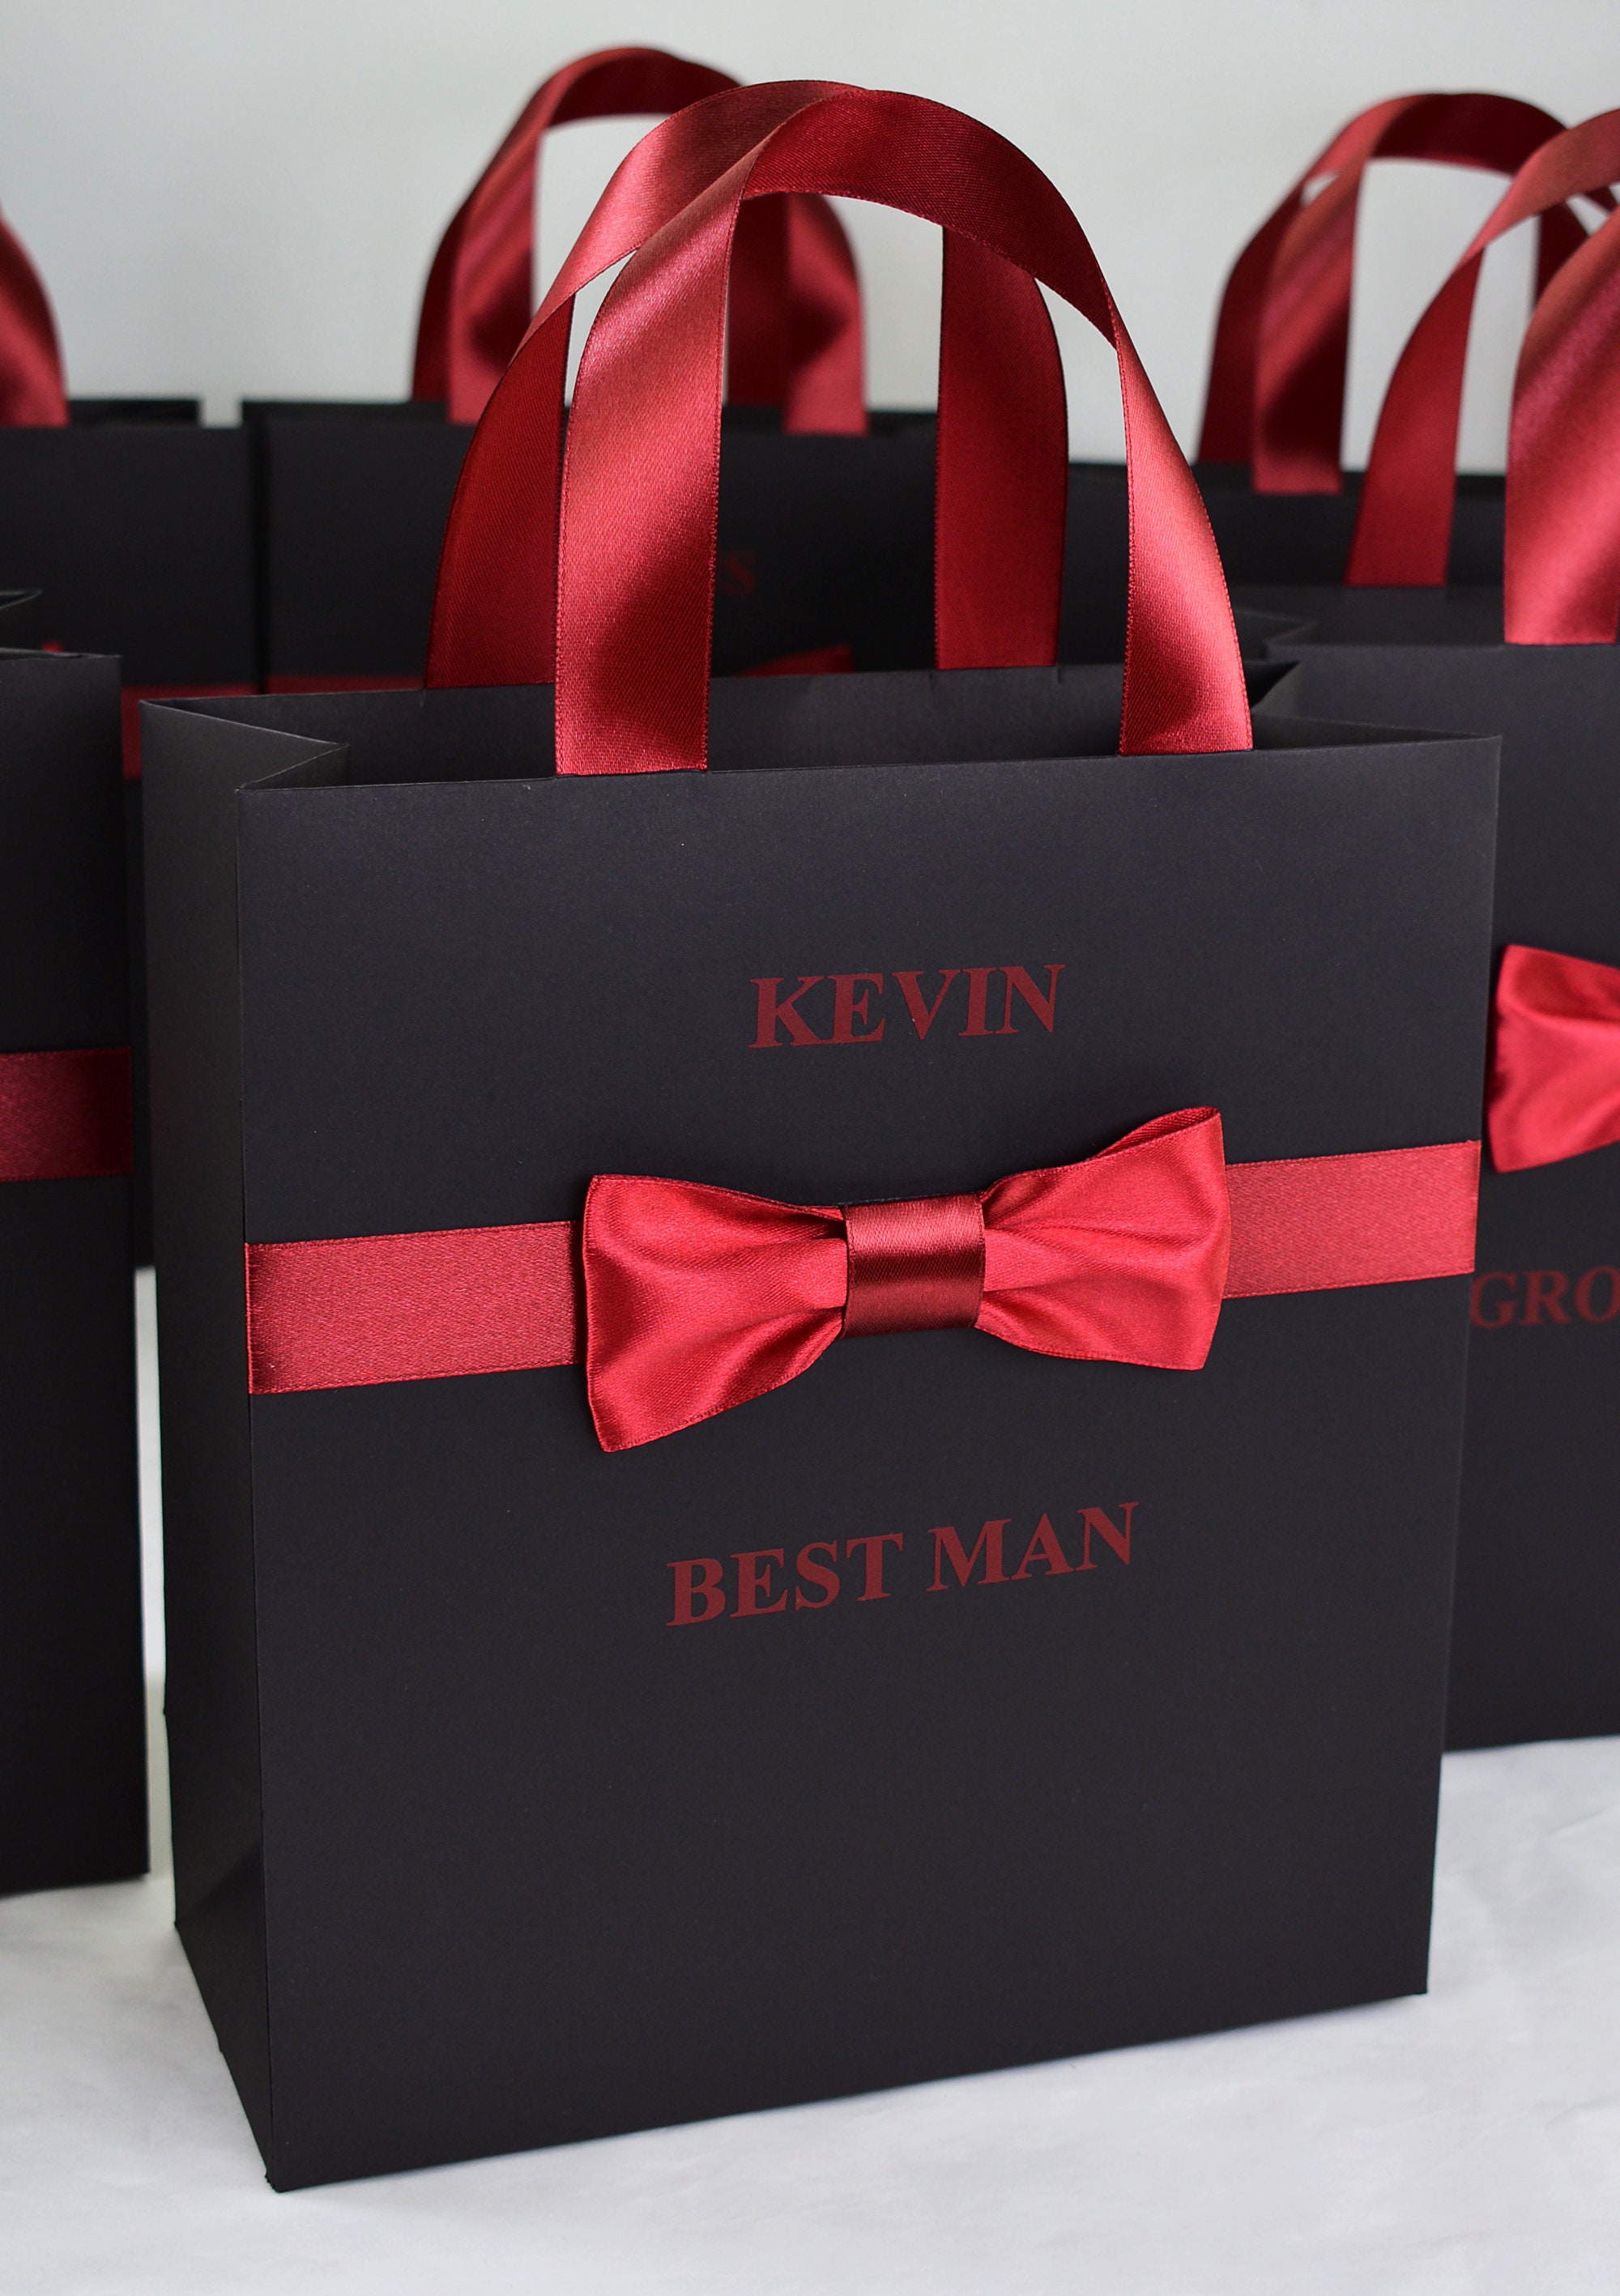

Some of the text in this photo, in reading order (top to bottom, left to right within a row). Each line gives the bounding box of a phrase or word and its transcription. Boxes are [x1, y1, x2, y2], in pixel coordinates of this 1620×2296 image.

[748, 964, 1067, 1050] KEVIN
[1470, 1266, 1620, 1328] GRO
[667, 1502, 1139, 1627] BEST MAN
